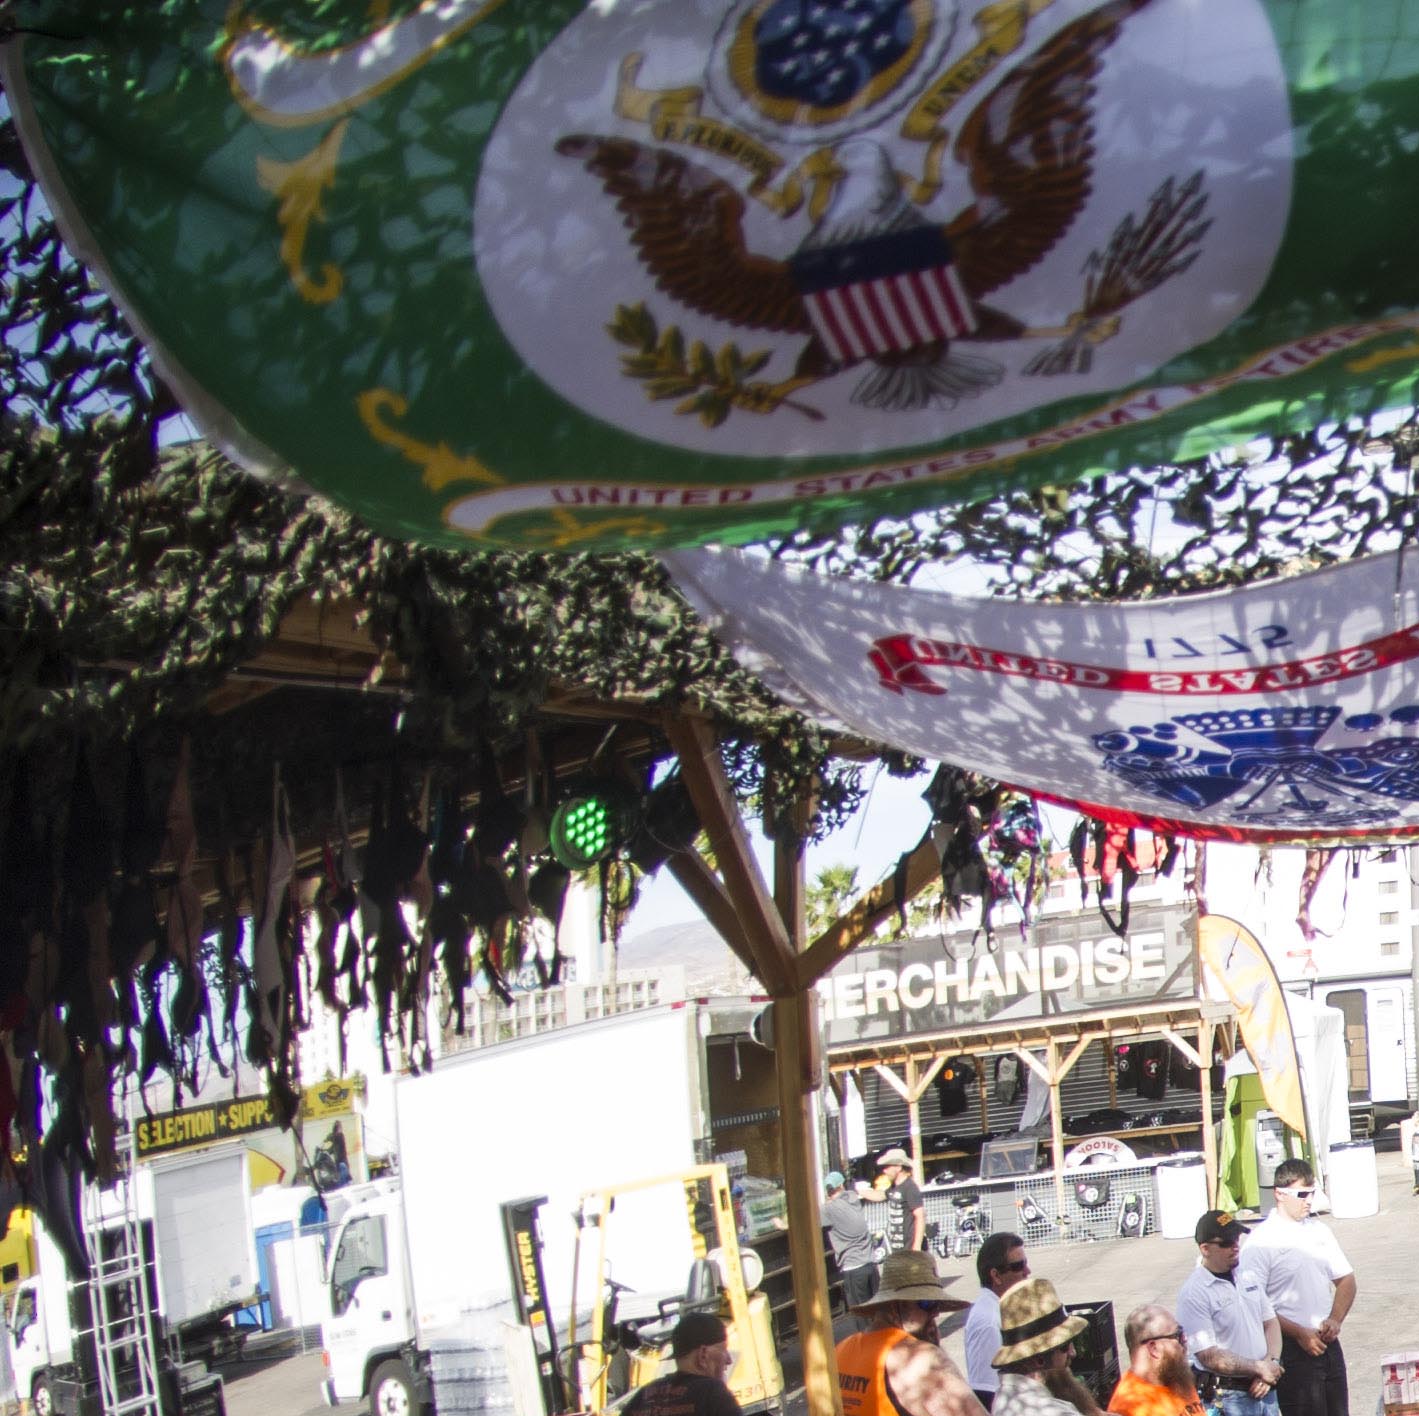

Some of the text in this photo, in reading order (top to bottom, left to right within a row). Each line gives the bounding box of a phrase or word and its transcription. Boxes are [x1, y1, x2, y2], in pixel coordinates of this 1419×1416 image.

[552, 485, 754, 508] UNITED
[799, 449, 998, 498] STATES
[1026, 393, 1167, 450] ARMY
[515, 1231, 540, 1301] HYSTER
